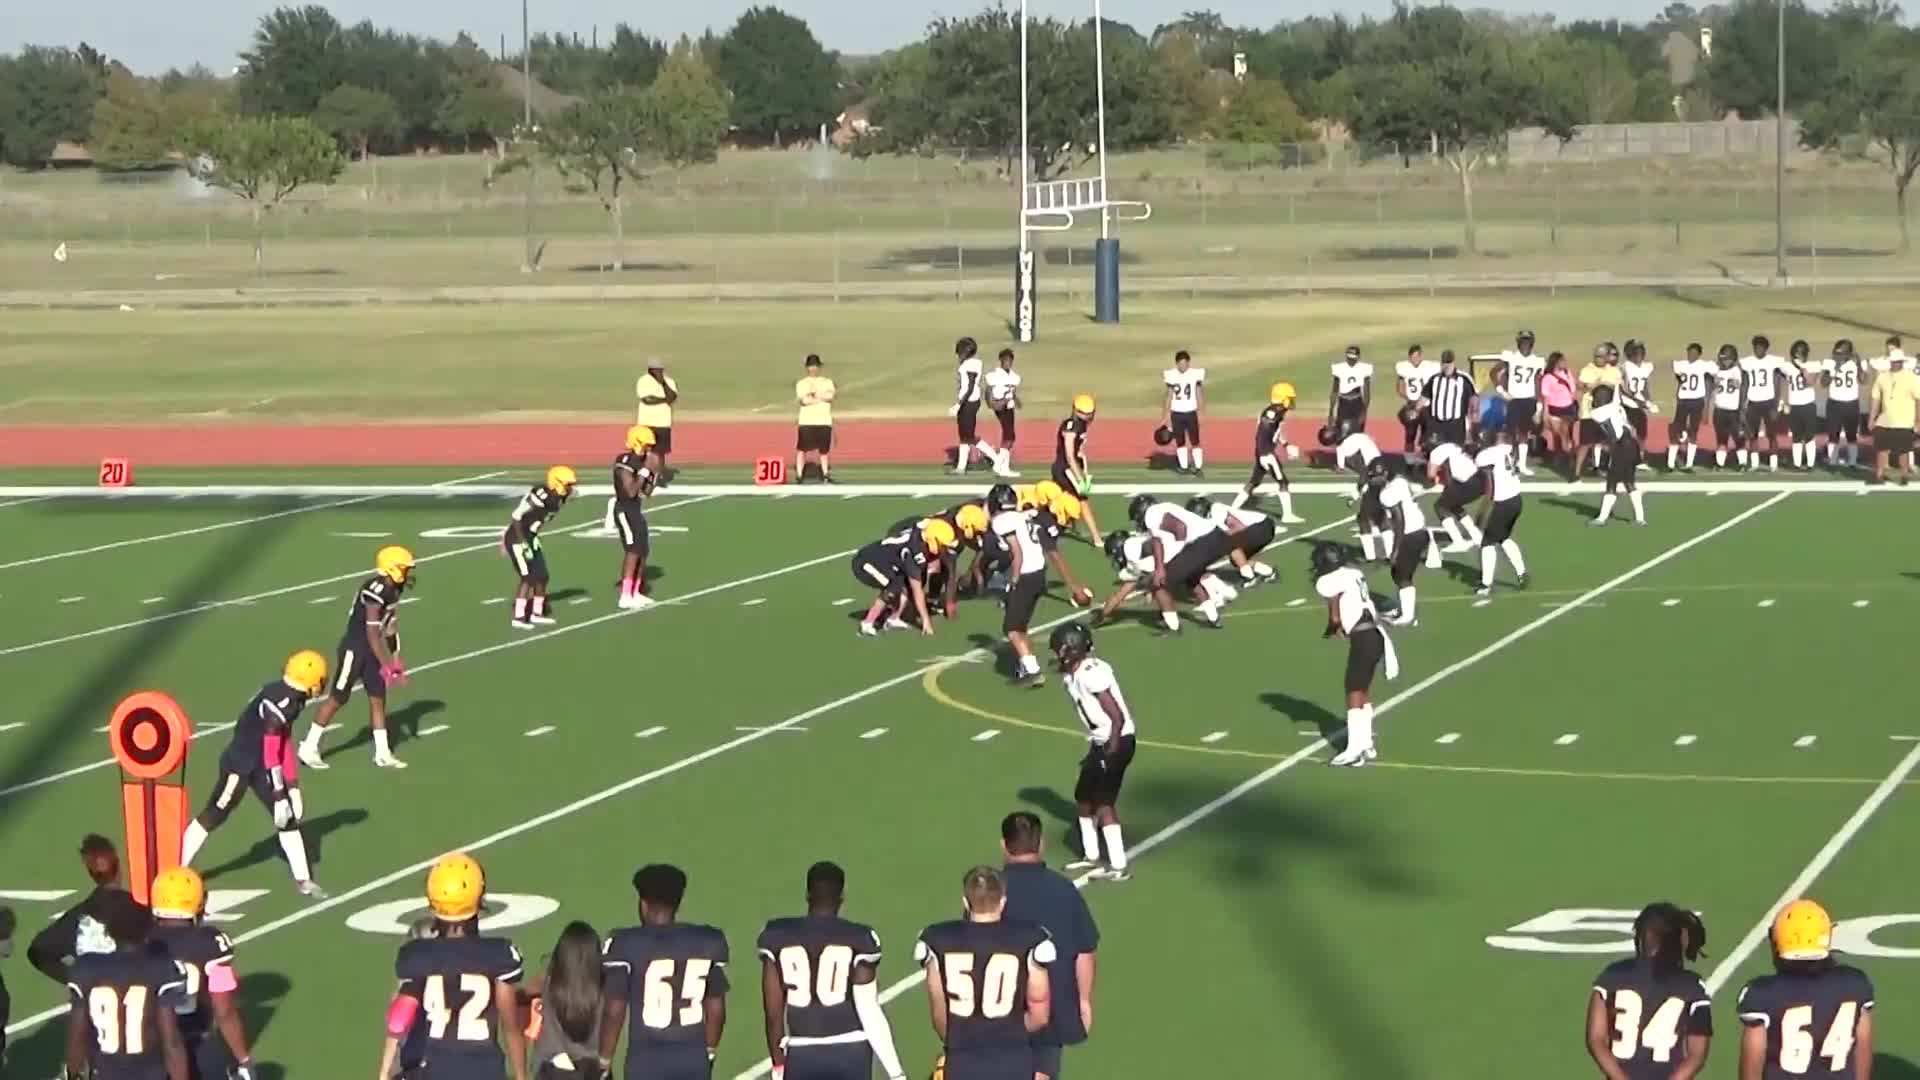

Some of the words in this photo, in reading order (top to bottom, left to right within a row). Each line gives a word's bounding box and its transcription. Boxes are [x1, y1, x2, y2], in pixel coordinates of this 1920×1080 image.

[1171, 383, 1191, 400] 24
[1513, 365, 1534, 384] 57
[1752, 368, 1768, 387] 13
[102, 463, 124, 483] 20
[759, 460, 780, 480] 30
[423, 973, 491, 1040] 42
[642, 958, 712, 1029] 65
[779, 945, 852, 1007] 90
[944, 953, 1020, 1018] 50
[89, 985, 147, 1054] 91
[1611, 989, 1685, 1062] 34
[1780, 1001, 1857, 1074] 64
